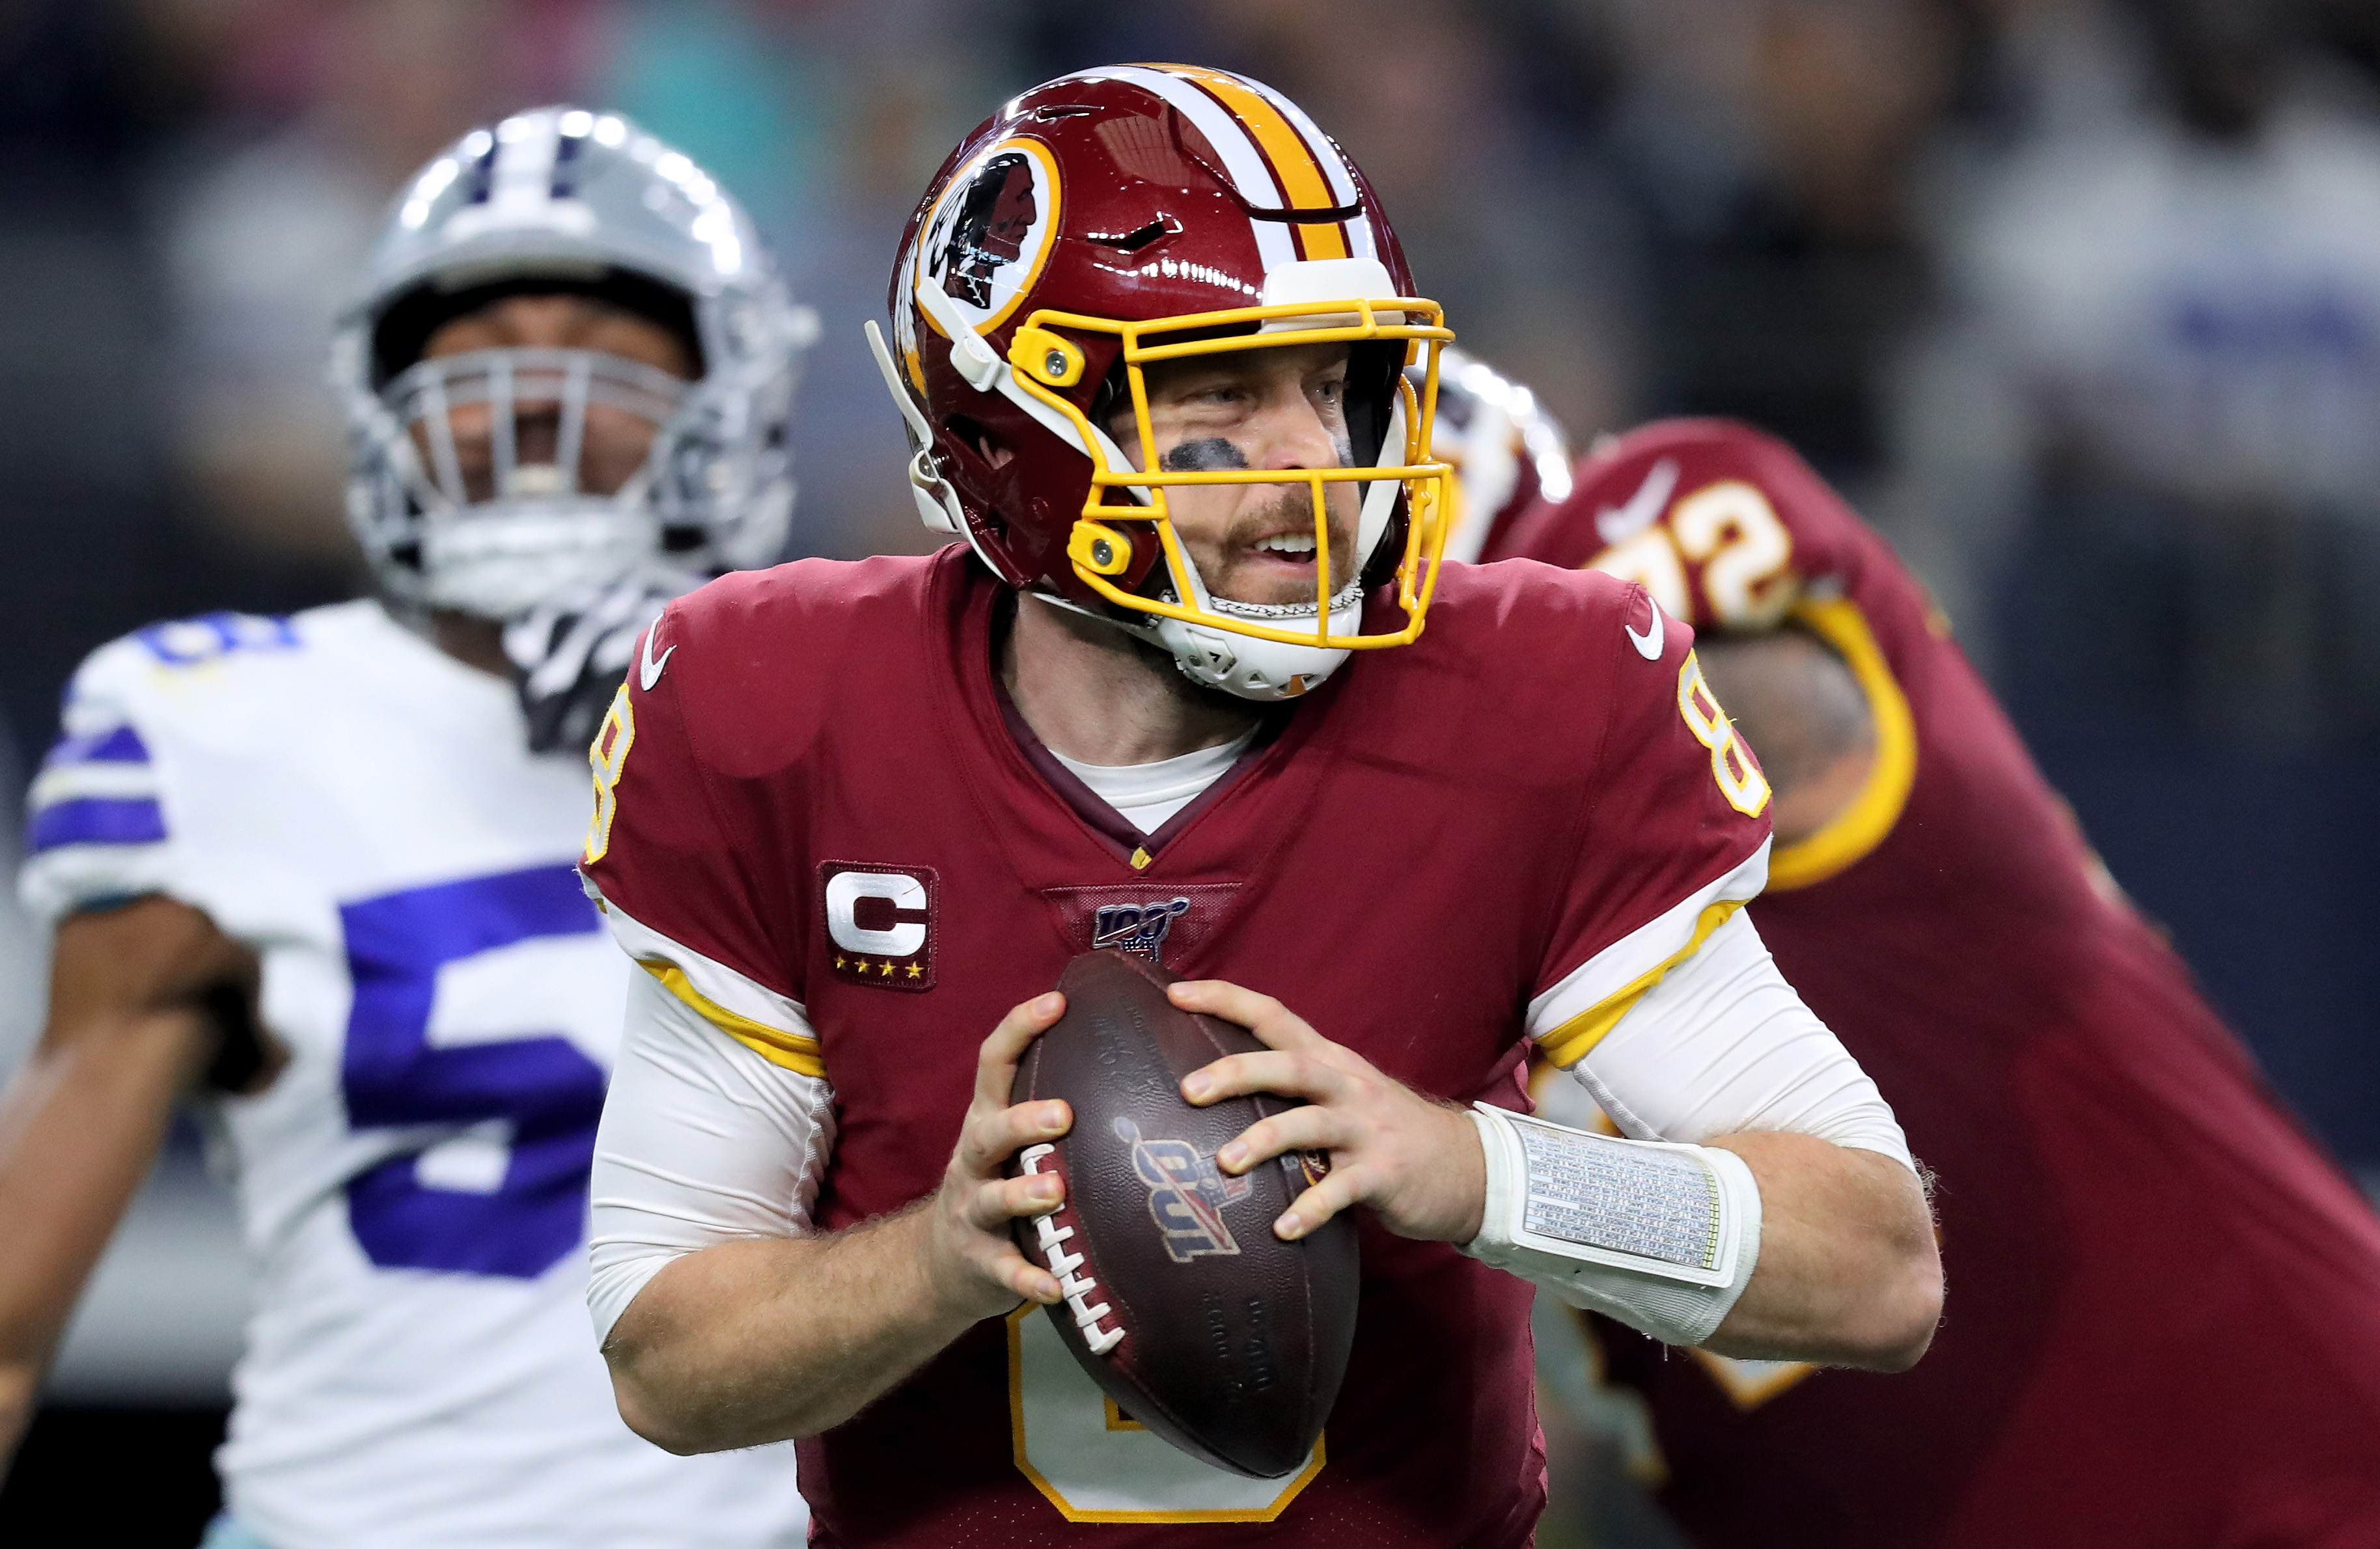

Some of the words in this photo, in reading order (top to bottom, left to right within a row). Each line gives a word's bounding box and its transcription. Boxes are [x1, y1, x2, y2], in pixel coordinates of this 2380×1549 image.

[585, 682, 635, 866] 8
[1678, 648, 1772, 818] 8
[825, 871, 927, 957] C
[1094, 903, 1170, 948] 100
